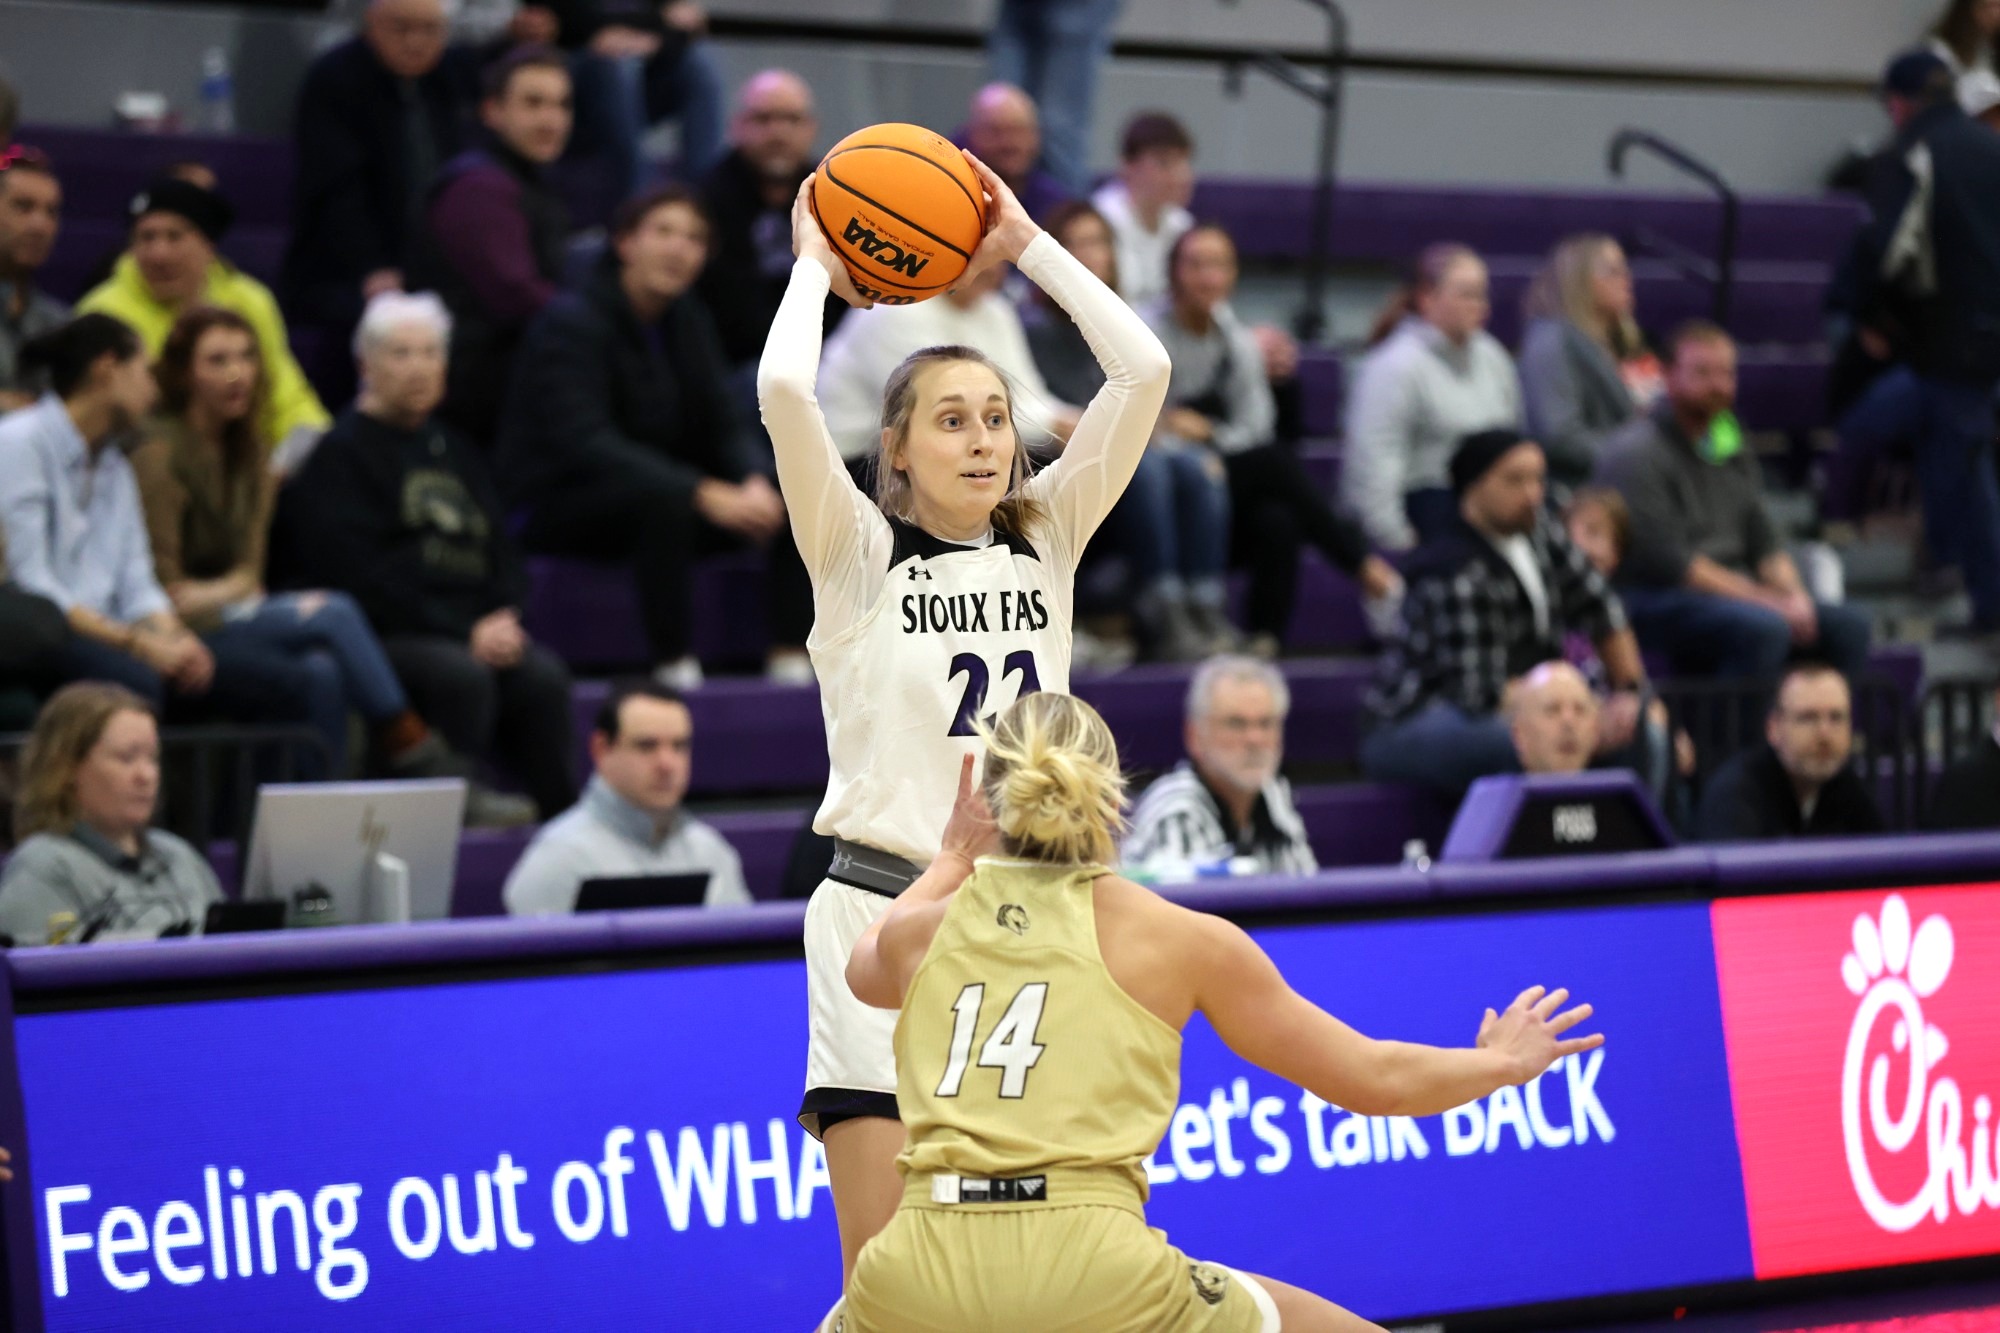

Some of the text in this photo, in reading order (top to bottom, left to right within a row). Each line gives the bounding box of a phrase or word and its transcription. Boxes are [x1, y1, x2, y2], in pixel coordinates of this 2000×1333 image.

[842, 216, 930, 279] NCAA
[876, 226, 900, 243] GAME
[901, 592, 990, 634] SIOUX
[934, 982, 1050, 1099] 14
[1841, 976, 2000, 1233] Chi
[43, 1163, 370, 1303] Feeling
[386, 1150, 535, 1261] out
[550, 1124, 636, 1244] of
